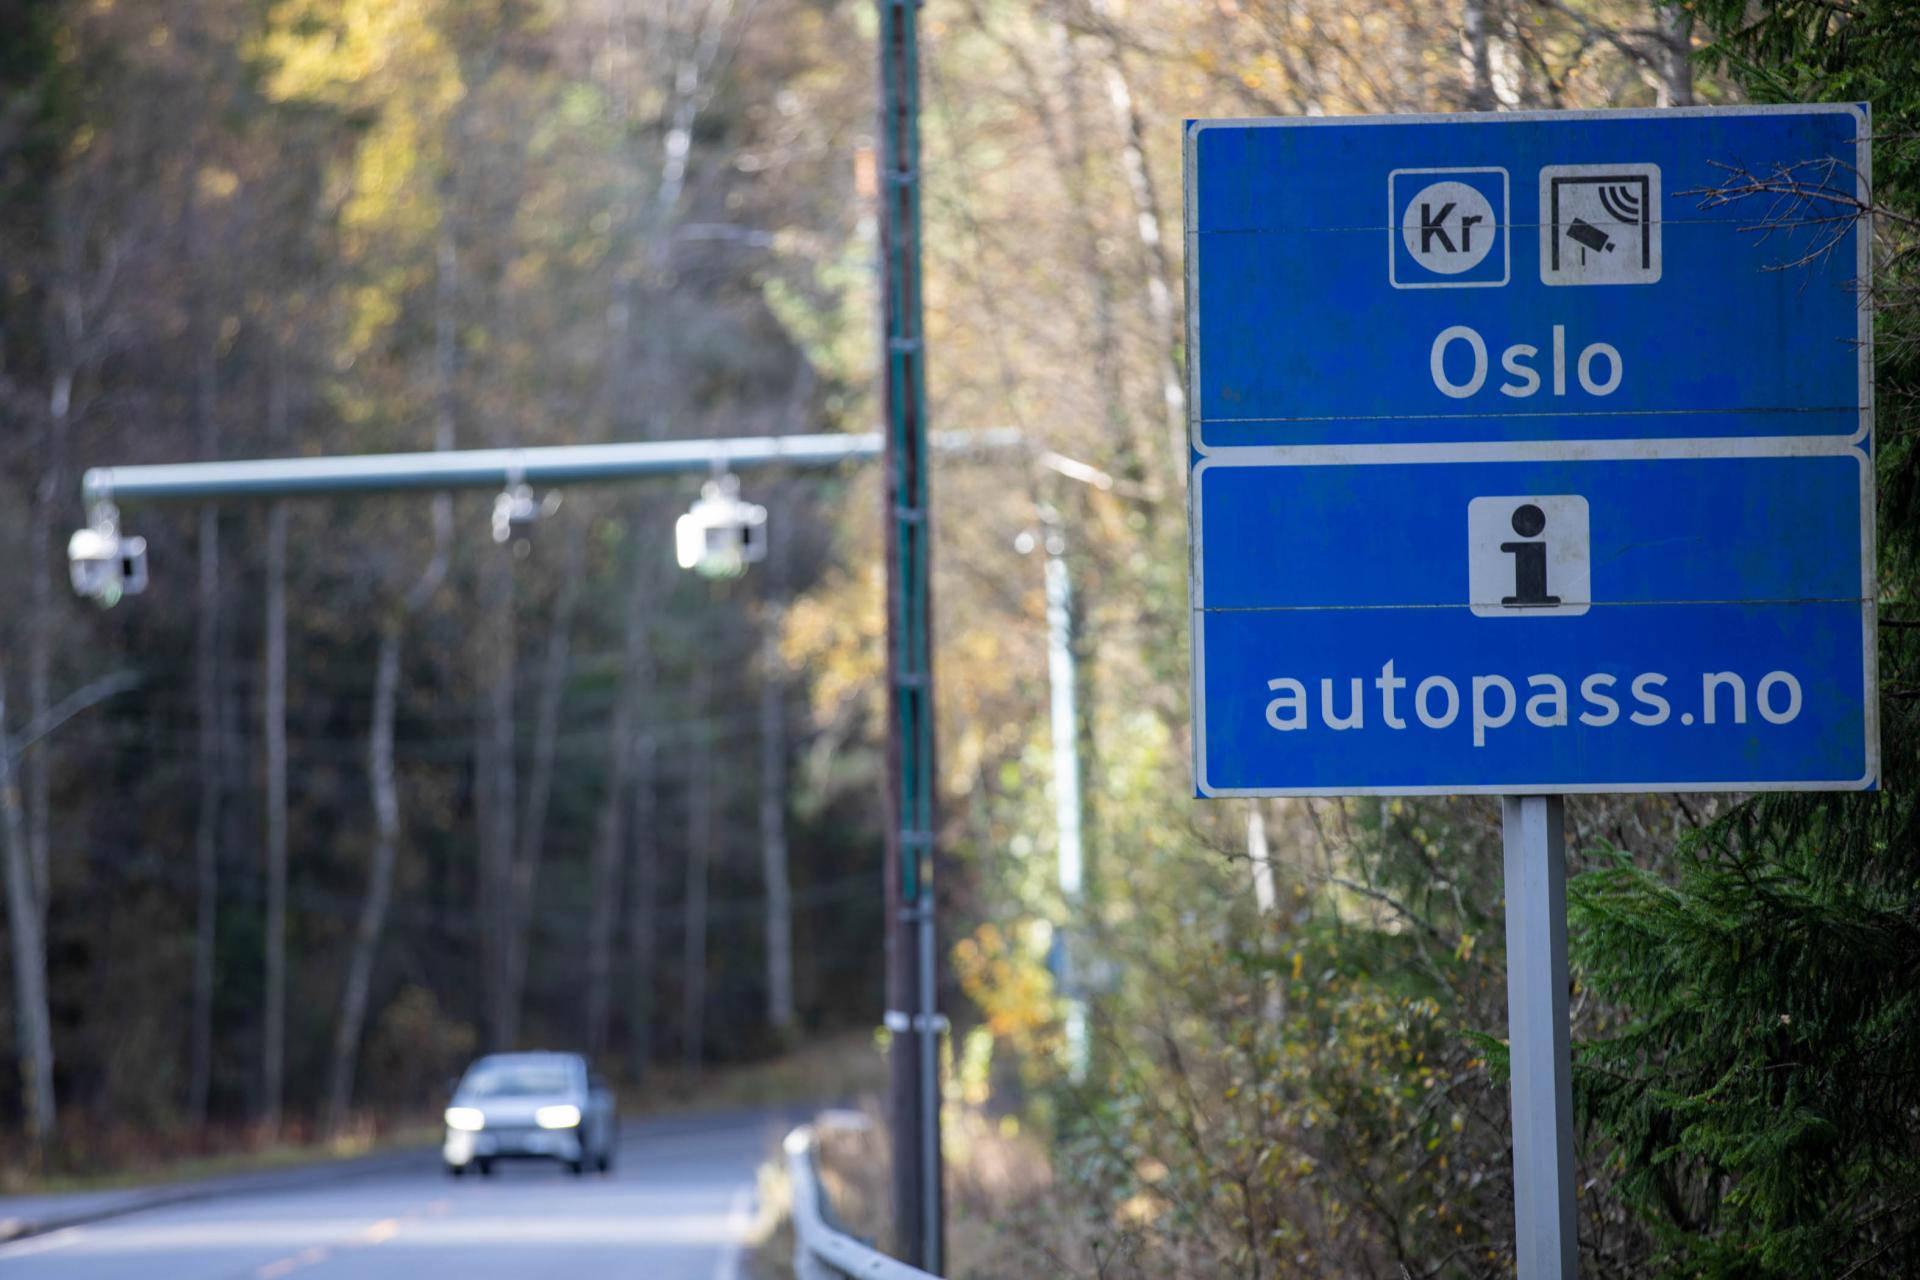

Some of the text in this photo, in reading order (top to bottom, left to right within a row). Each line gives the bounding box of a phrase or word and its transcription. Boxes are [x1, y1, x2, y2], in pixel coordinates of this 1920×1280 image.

[1421, 202, 1483, 253] Kr
[1430, 325, 1622, 398] Oslo
[1500, 504, 1561, 606] i
[1265, 659, 1801, 746] autopass.no
